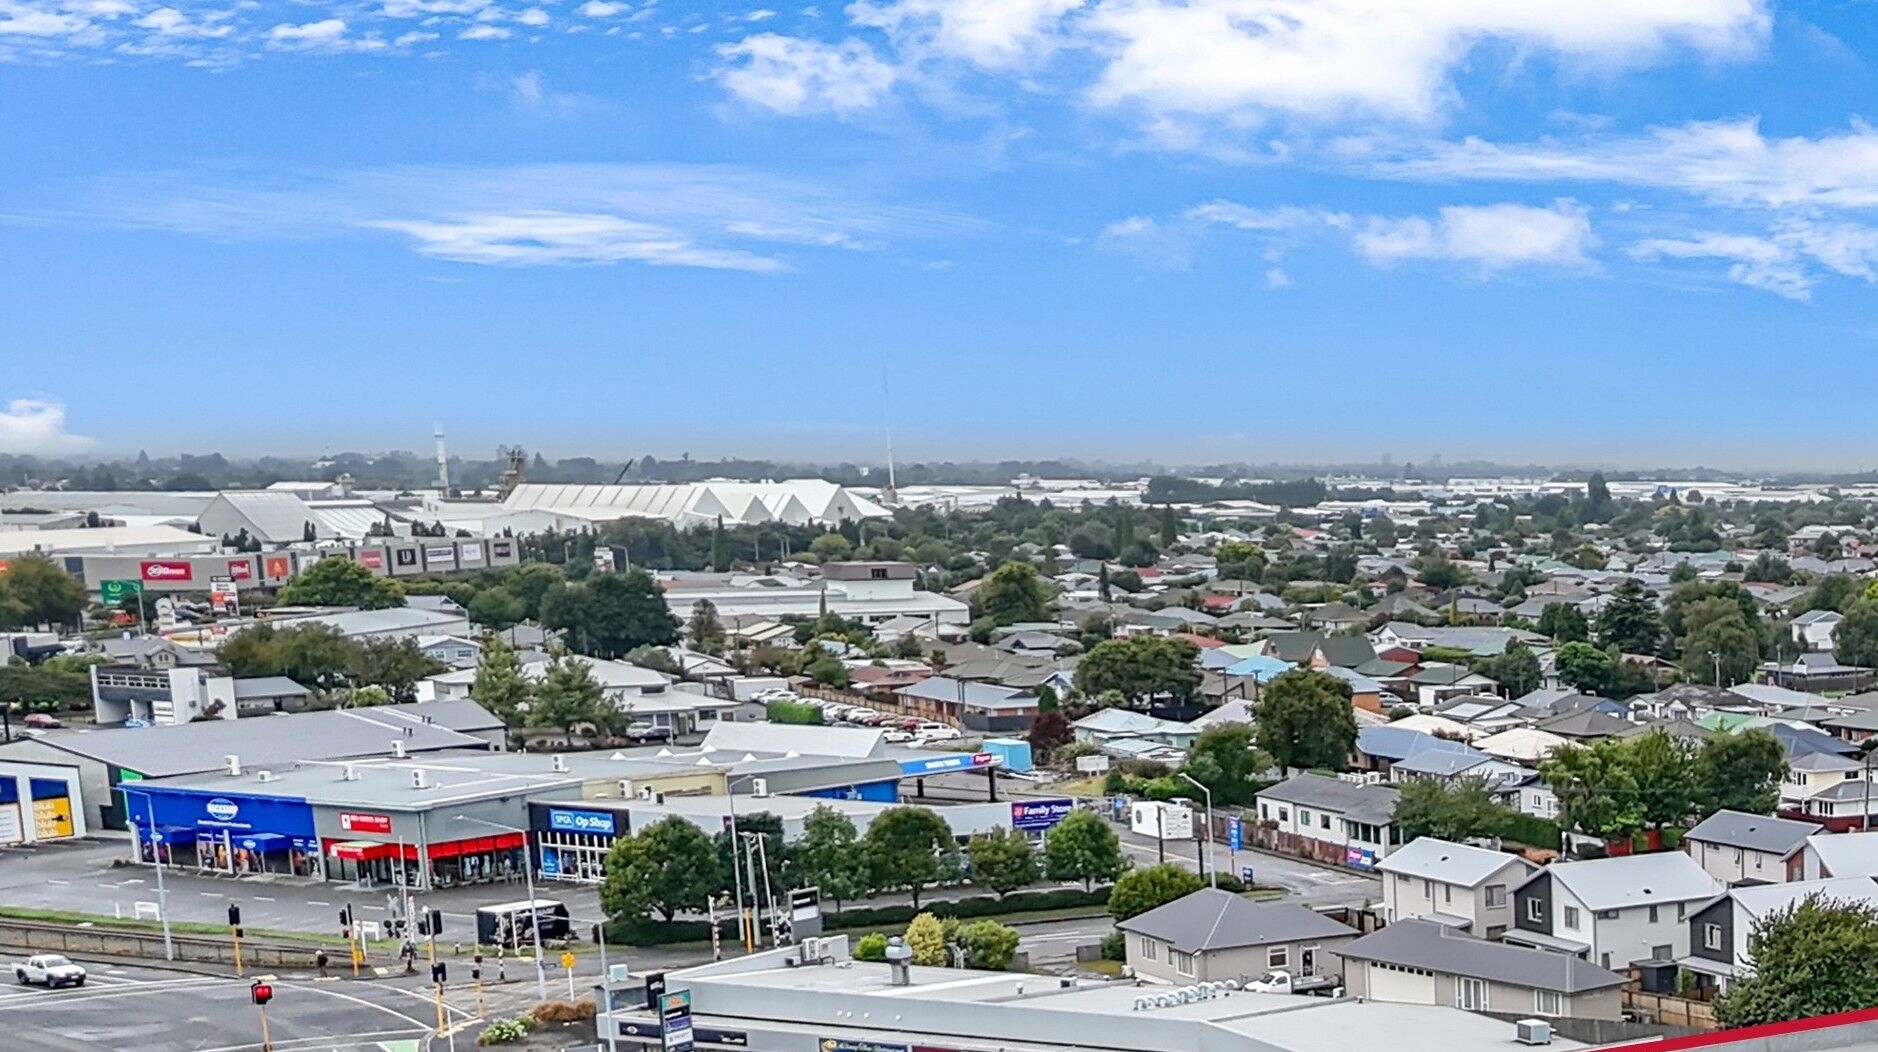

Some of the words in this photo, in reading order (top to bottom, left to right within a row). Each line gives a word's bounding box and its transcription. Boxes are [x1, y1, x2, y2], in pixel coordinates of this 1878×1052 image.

[1023, 805, 1050, 816] Family
[575, 816, 589, 828] Op
[589, 816, 611, 831] Shop
